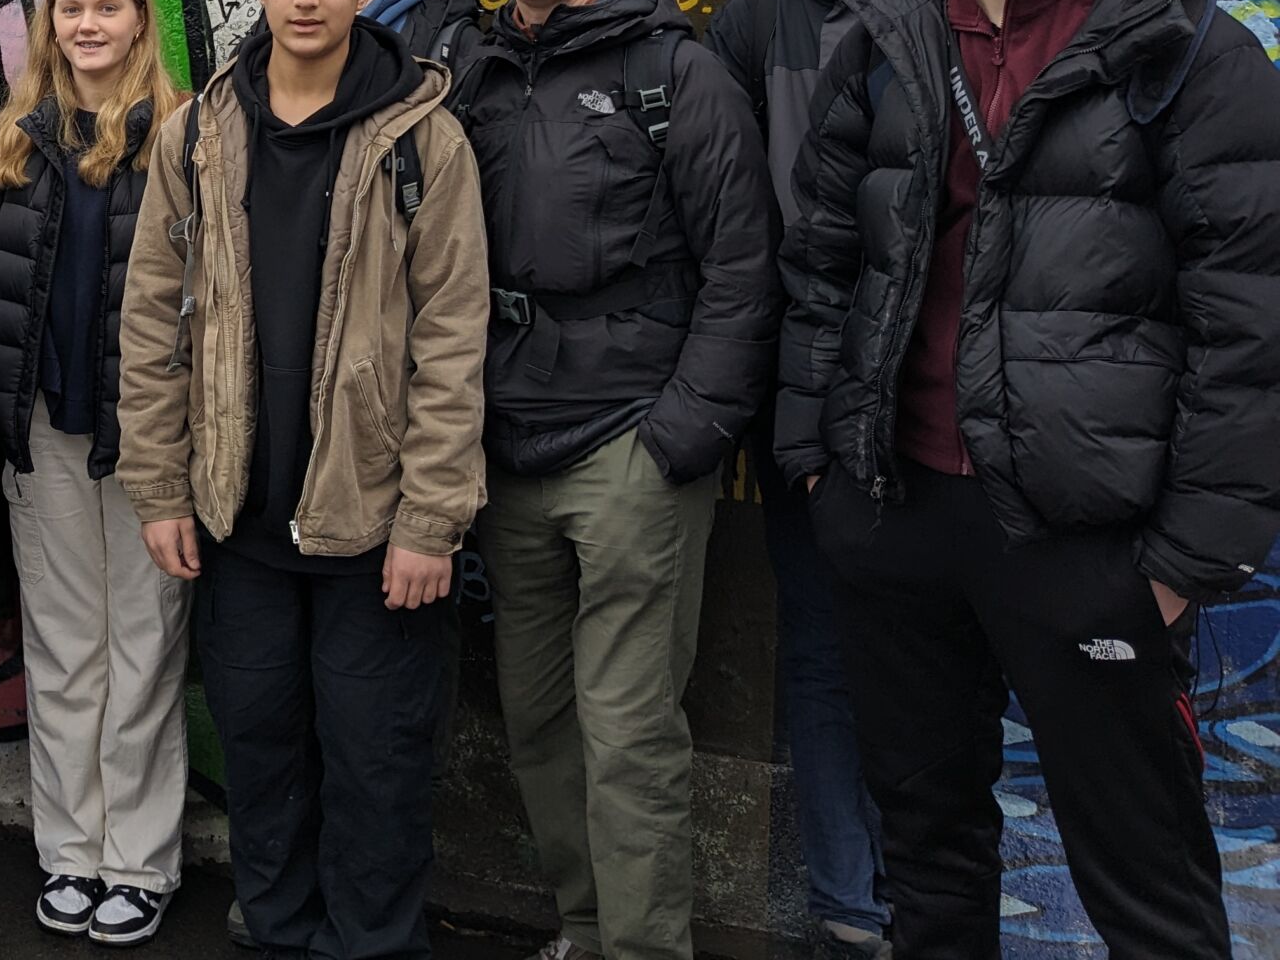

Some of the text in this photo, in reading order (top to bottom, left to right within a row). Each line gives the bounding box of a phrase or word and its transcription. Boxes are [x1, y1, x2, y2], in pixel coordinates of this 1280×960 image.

[578, 92, 604, 107] NORTH
[949, 66, 982, 147] UNDER
[1078, 642, 1115, 654] NORTH
[1092, 638, 1113, 647] THE
[1089, 651, 1117, 661] FACE
